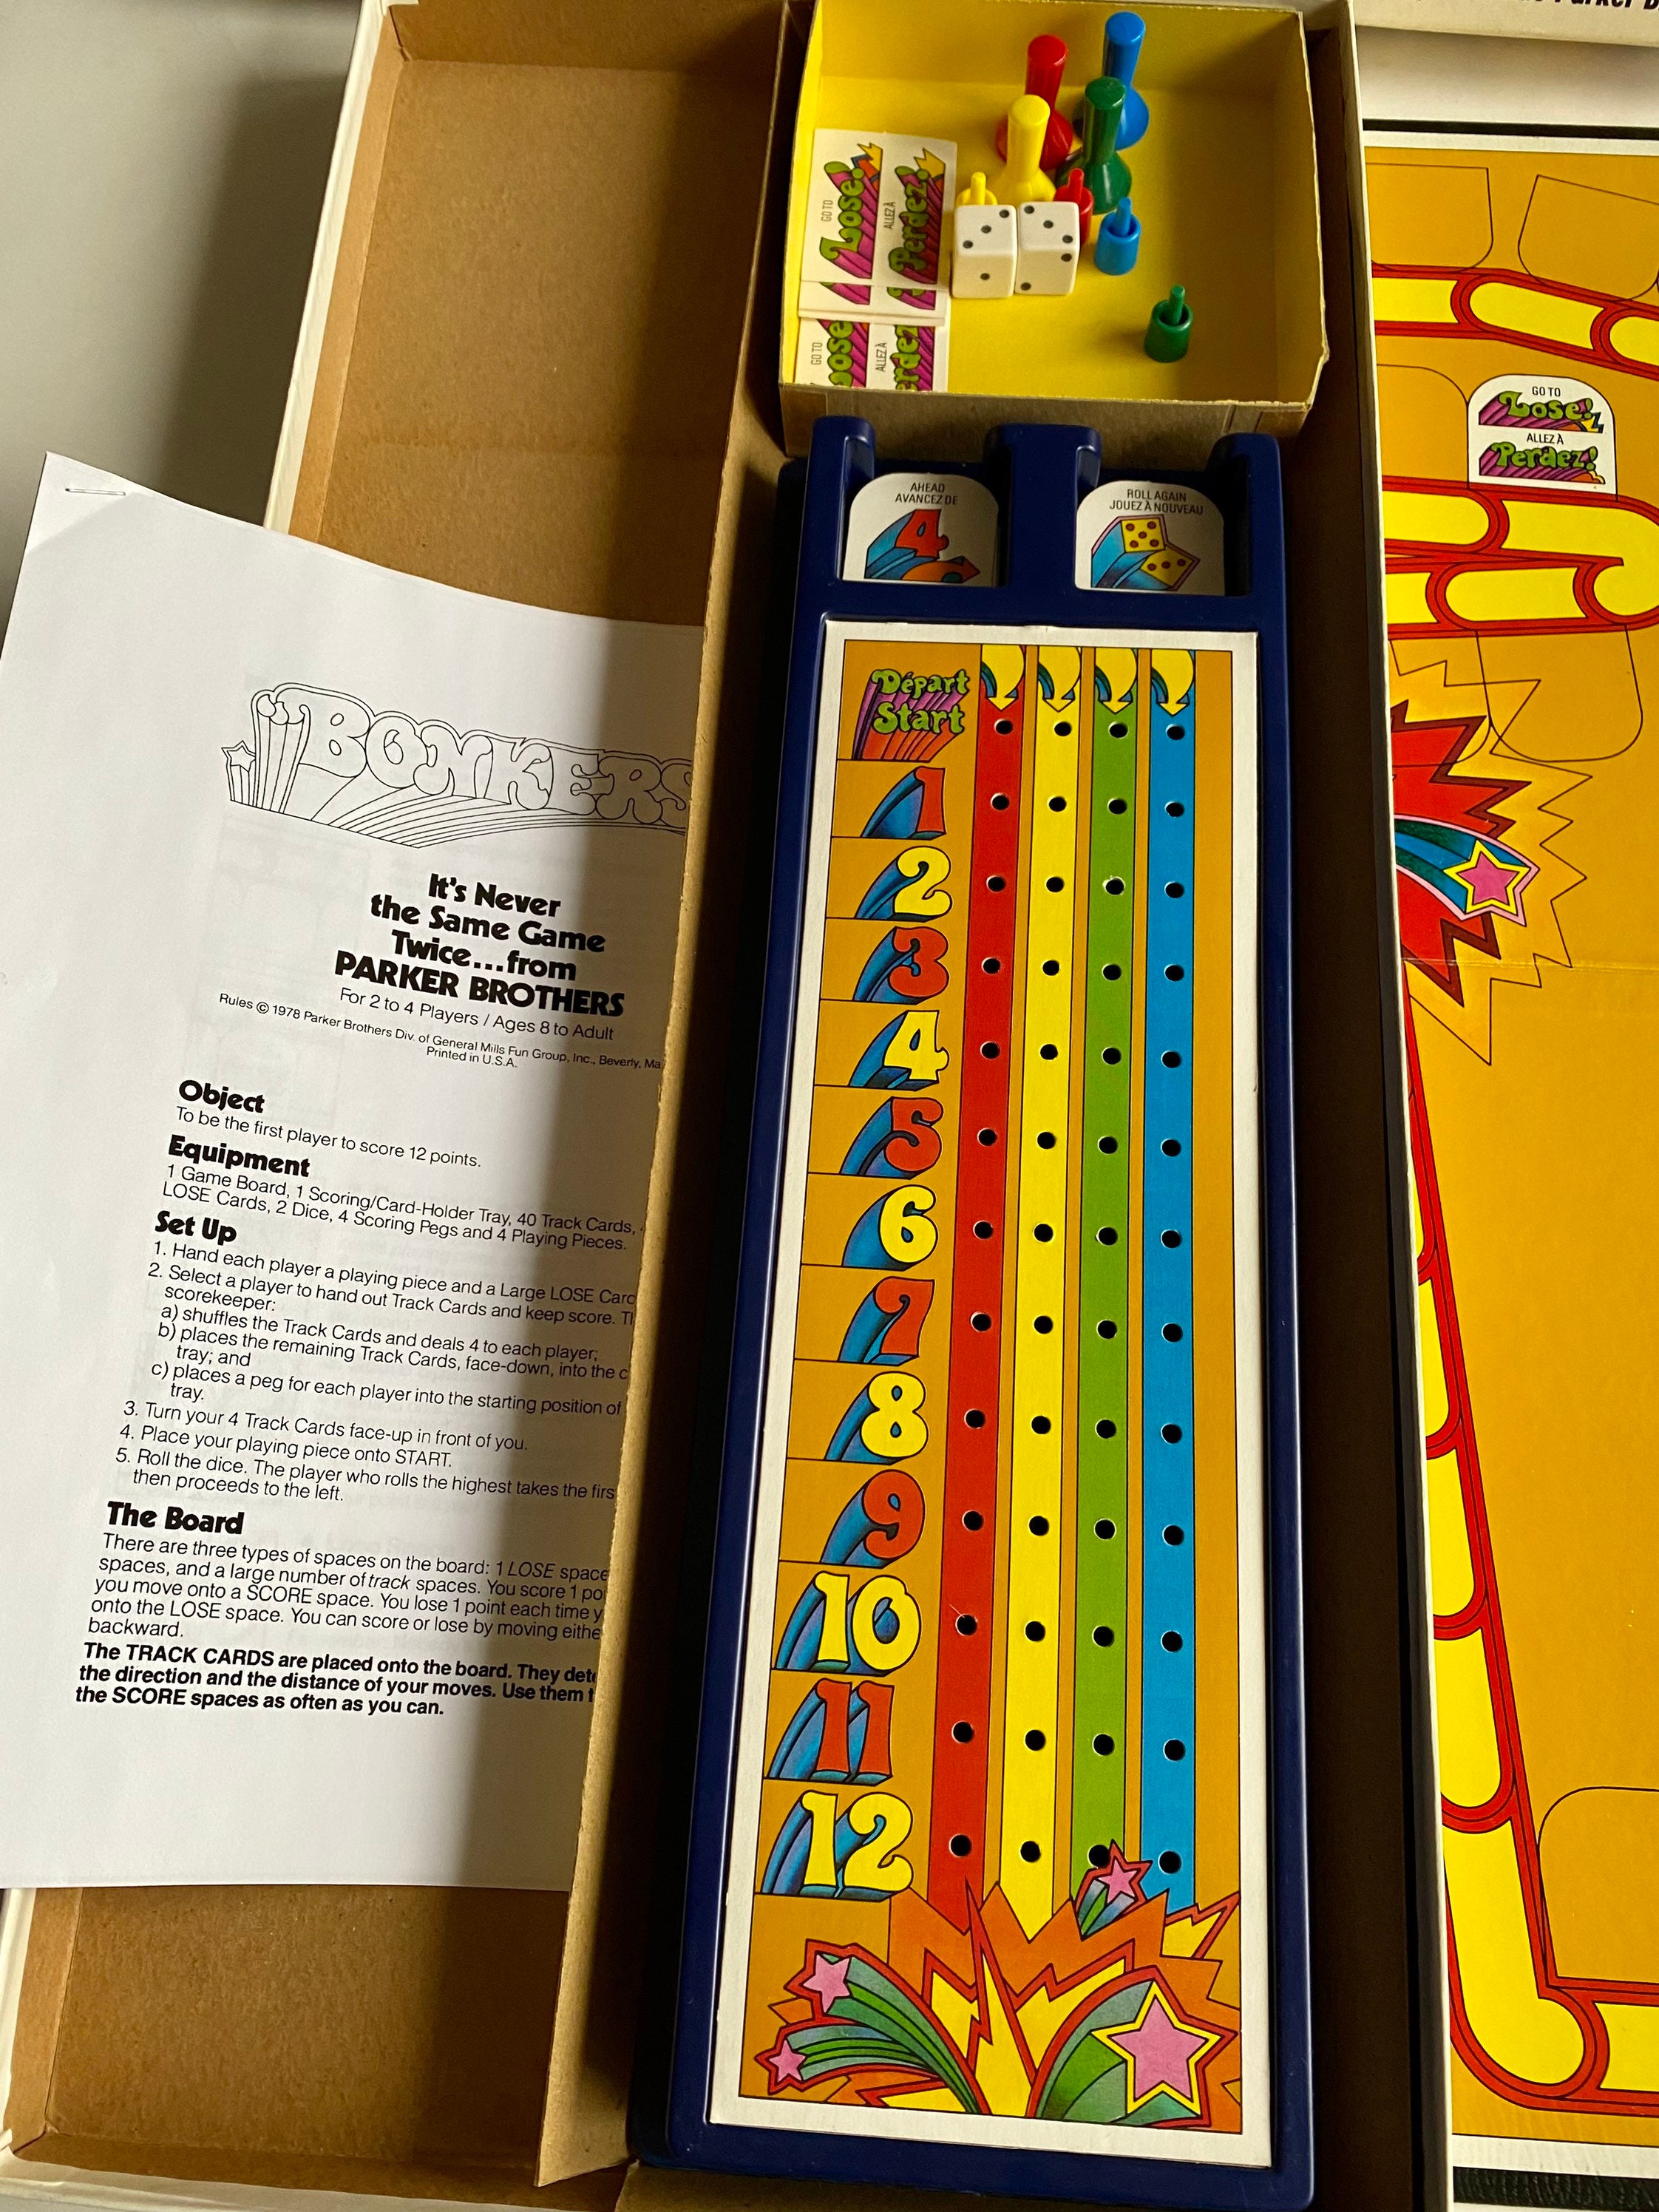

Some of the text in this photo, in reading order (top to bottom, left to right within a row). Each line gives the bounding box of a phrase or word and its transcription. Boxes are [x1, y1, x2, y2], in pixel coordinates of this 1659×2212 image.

[821, 200, 833, 222] GO TO
[883, 207, 895, 229] ALLEZ
[811, 342, 823, 365] GO TO
[875, 349, 887, 372] ALLEZ
[1498, 390, 1594, 421] Lose!
[1532, 386, 1561, 397] GO TO
[1491, 441, 1598, 471] Perdez!
[1527, 432, 1564, 444] ALLEZ À
[895, 493, 958, 506] AVANCEZ DE
[910, 482, 945, 493] AHEAD
[1110, 500, 1204, 515] JOUEZ À NOUVEAU
[1127, 489, 1187, 502] ROLL AGAIN
[895, 509, 949, 558] 4
[871, 668, 971, 694] Départ
[873, 702, 966, 734] Start
[914, 767, 946, 834] 1
[428, 872, 562, 917] It's Never
[895, 847, 952, 916] 2
[370, 893, 606, 953] the Same Game
[334, 949, 625, 1017] PARKER BROTHERS
[889, 926, 949, 999] 3
[219, 993, 254, 1009] Rules
[256, 1001, 270, 1014] ©
[272, 1005, 301, 1020] 1978
[303, 1011, 342, 1028] Parker
[343, 1019, 393, 1037] Brothers
[395, 1028, 417, 1041] Div.
[418, 1034, 430, 1043] of
[432, 1035, 478, 1051] General
[480, 1042, 505, 1055] Mills
[508, 1045, 529, 1057] Fun
[532, 1048, 570, 1063] Group,
[599, 1054, 642, 1070] Beverly,
[340, 987, 614, 1041] For 2 to 4 Players / Ages 8 to Adult
[427, 1045, 519, 1069] Printed in U.S.A.
[884, 1010, 949, 1081] 4
[178, 1079, 265, 1114] Object
[168, 1133, 311, 1178] Equipment
[176, 1105, 481, 1167] To be the first player to score 12 points.
[884, 1097, 943, 1171] 5
[168, 1164, 636, 1236] 1 Game Board, 1 Scoring/Card-Holder Tray, 40 Track Cards,
[155, 1210, 237, 1246] Set Up
[879, 1185, 937, 1263] 6
[164, 1286, 278, 1312] scorekeeper:
[875, 1278, 934, 1357] 7
[177, 1344, 251, 1367] tray; and
[123, 1400, 528, 1452] 3. Turn your 4 Track Cards face-up in front of you.
[861, 1372, 928, 1458] 8
[119, 1423, 452, 1468] 4. Place your playing piece onto START.
[106, 1500, 245, 1535] The Board
[863, 1470, 926, 1558] 9
[815, 1571, 921, 1670] 10
[79, 1664, 589, 1703] the direction and the distance of your moves. Use them
[84, 1641, 561, 1686] The TRACK CARDS are placed onto the board. They
[75, 1685, 444, 1716] the SCORE spaces as often as you can.
[817, 1679, 895, 1776] 11
[801, 1791, 913, 1890] 12
